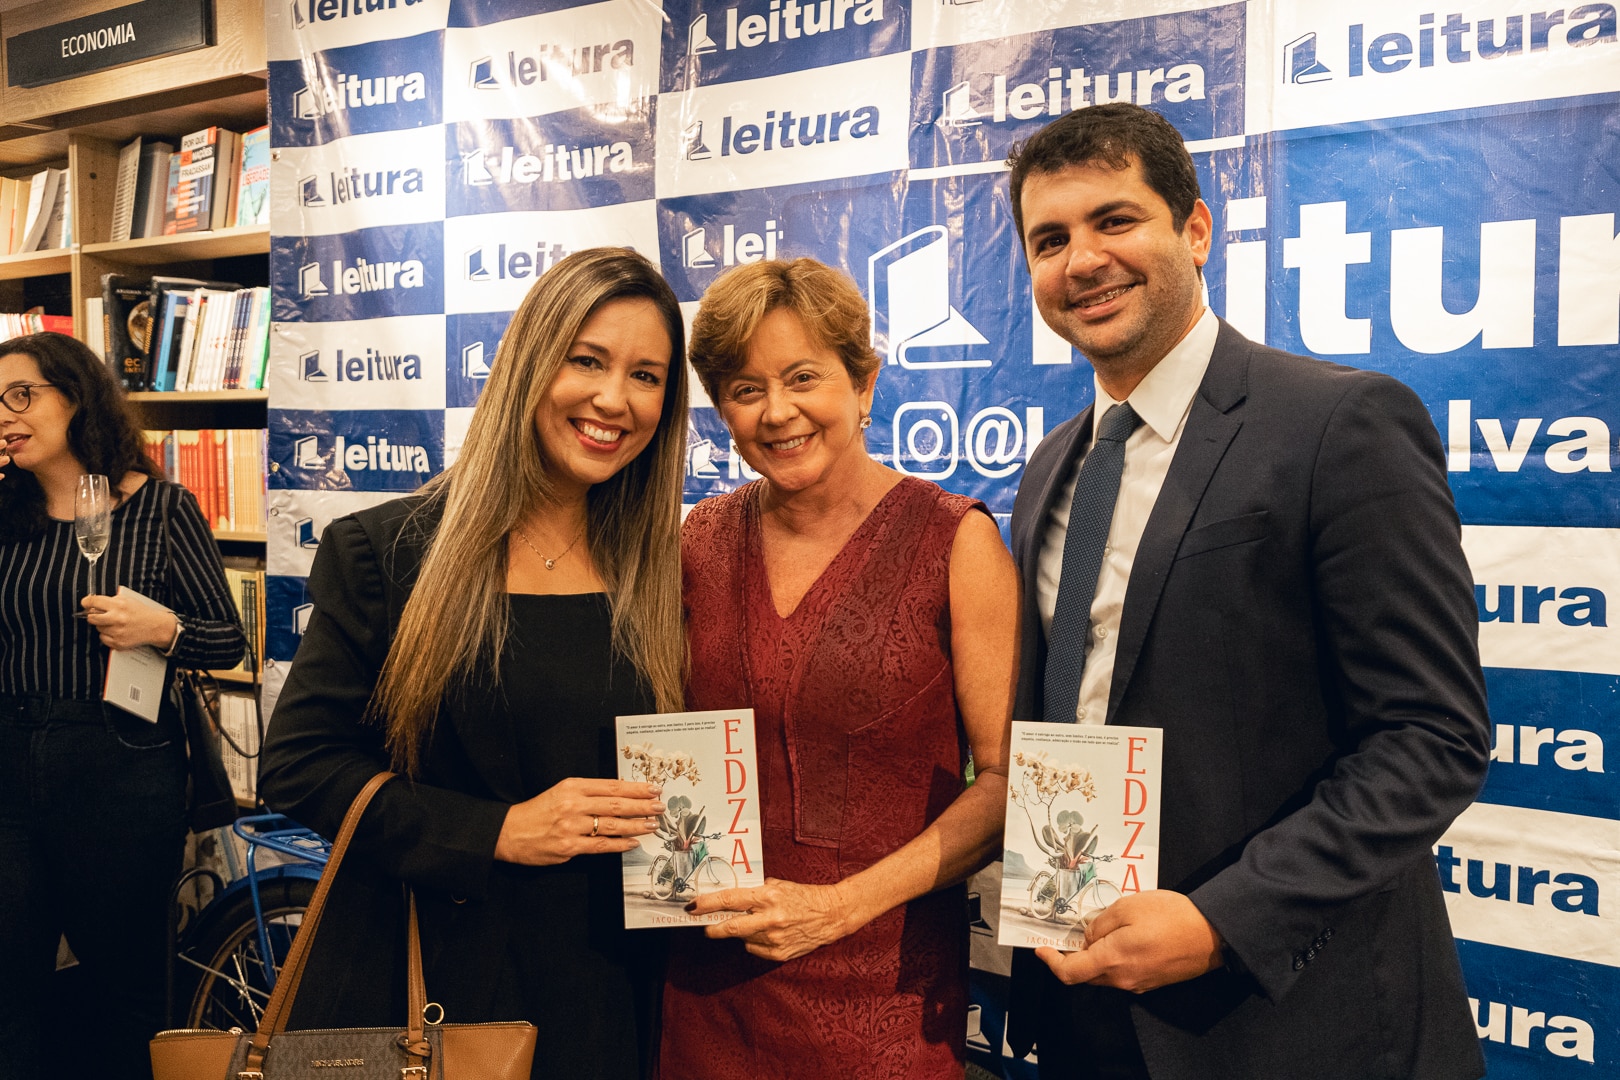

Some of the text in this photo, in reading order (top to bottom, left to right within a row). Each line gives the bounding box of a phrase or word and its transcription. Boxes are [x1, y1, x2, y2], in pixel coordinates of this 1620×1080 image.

[62, 22, 136, 58] ECONOMIA
[726, 0, 884, 50] leitura
[1349, 3, 1618, 77] leitura
[993, 63, 1206, 122] leitura
[721, 106, 880, 157] leitura
[331, 167, 423, 205] leitura
[501, 142, 633, 184] leitura
[724, 220, 783, 266] lei
[333, 257, 424, 295] leitura
[337, 348, 422, 382] leitura
[334, 436, 431, 473] leitura
[724, 719, 752, 874] EDZA
[1121, 737, 1148, 893] EDZA
